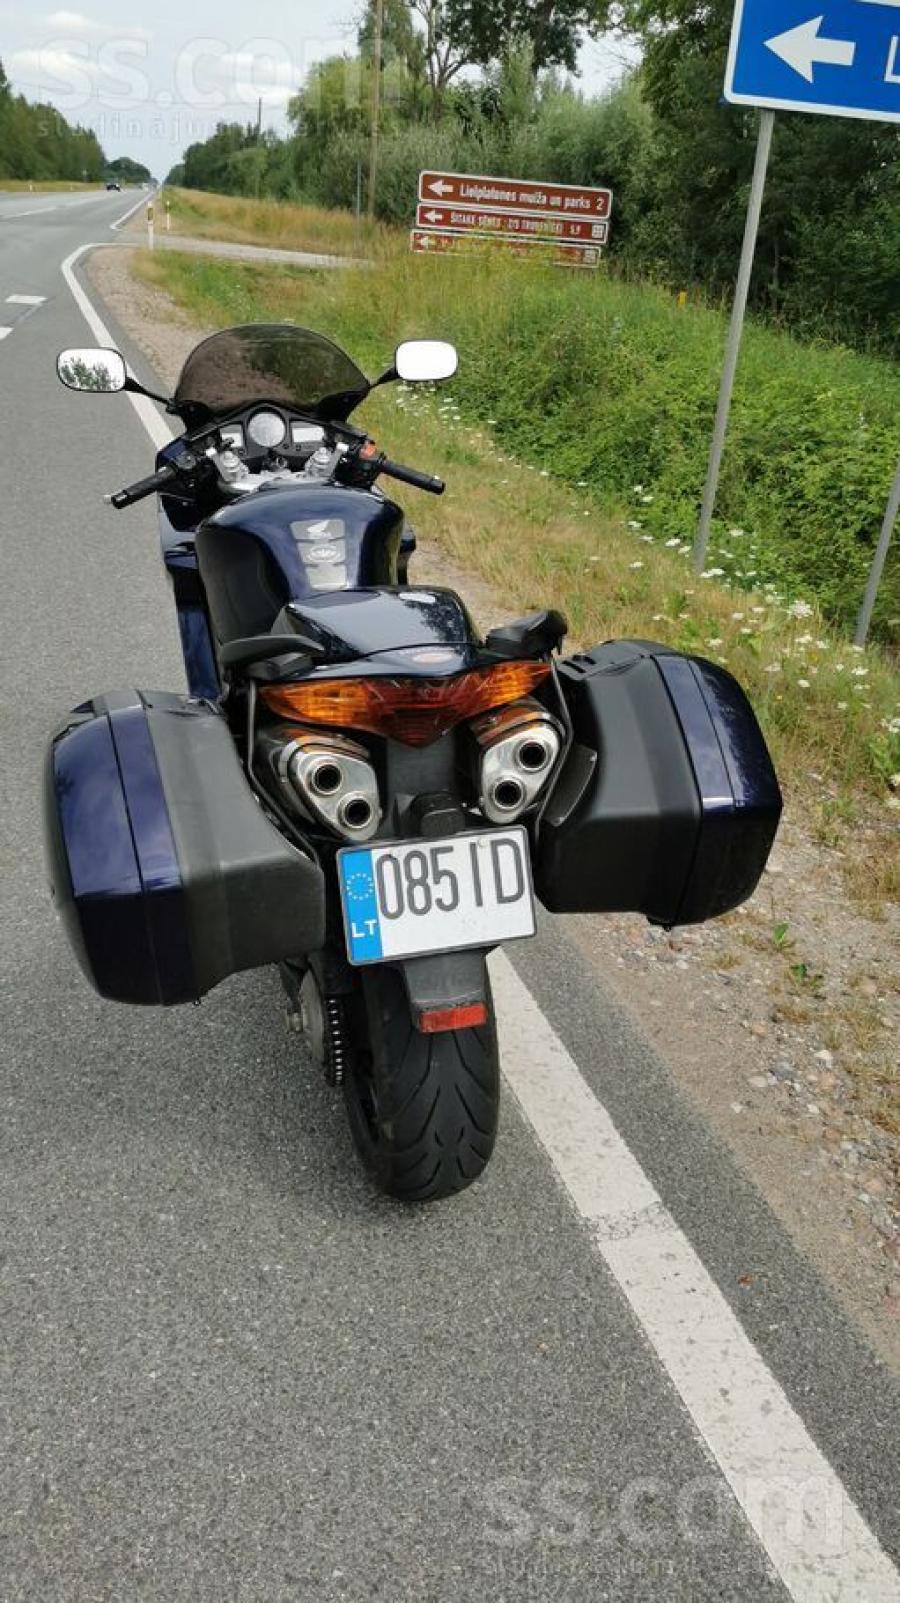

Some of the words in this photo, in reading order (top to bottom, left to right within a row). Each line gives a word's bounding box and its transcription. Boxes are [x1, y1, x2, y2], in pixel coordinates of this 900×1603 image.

[549, 195, 561, 206] un
[564, 196, 591, 209] parks
[595, 197, 605, 211] 2
[350, 919, 377, 938] LT
